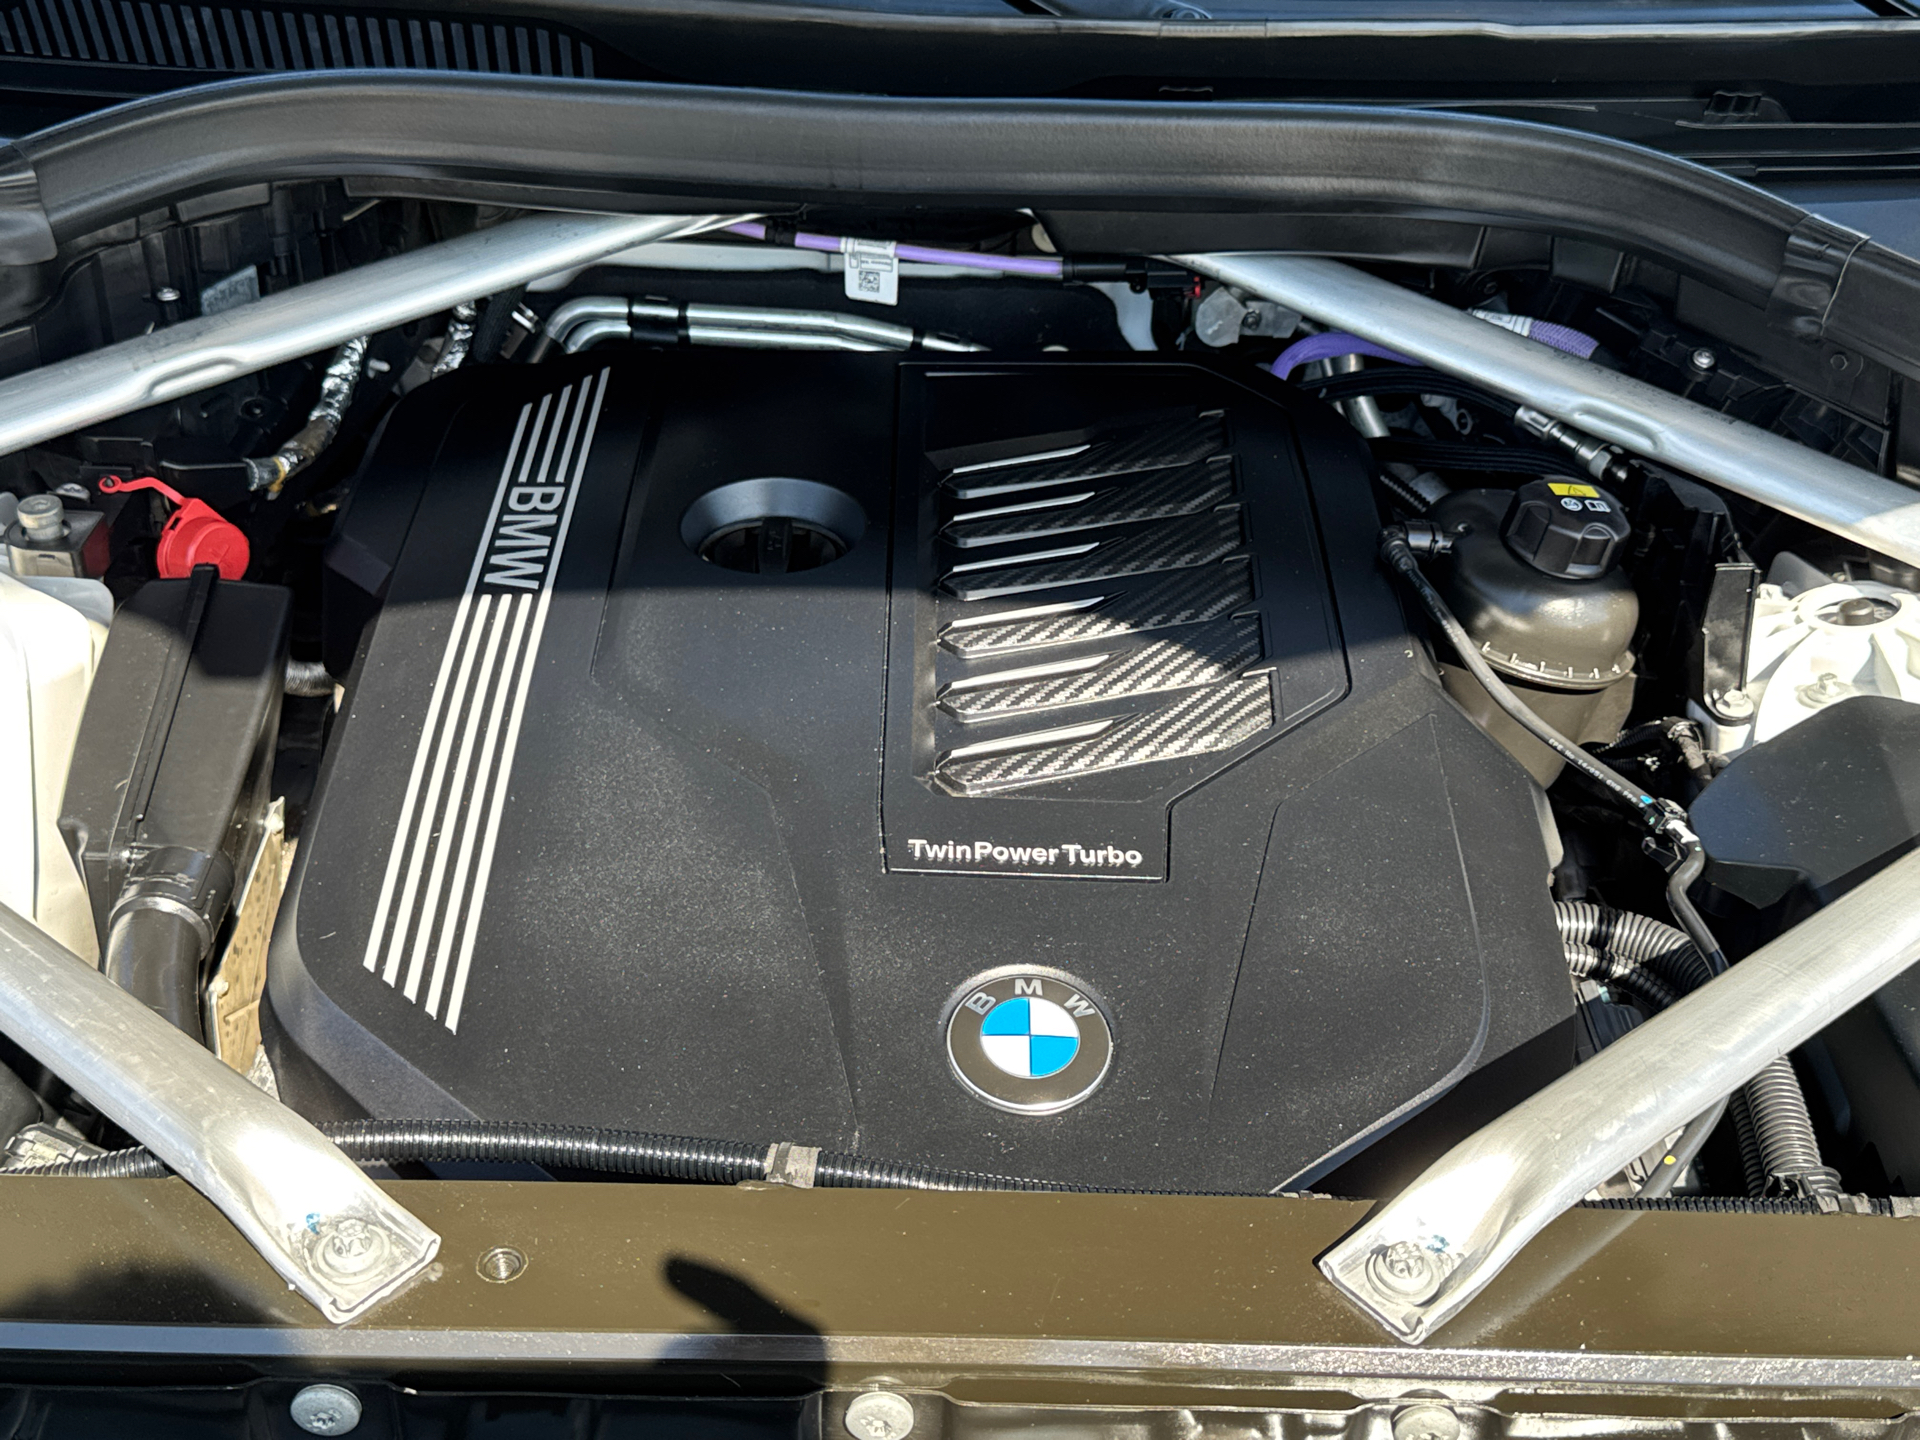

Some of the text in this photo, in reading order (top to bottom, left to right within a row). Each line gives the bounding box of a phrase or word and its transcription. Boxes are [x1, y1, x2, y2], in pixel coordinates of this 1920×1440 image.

[483, 486, 566, 590] BMW
[907, 838, 1143, 866] TwinPower Turbo
[965, 978, 1096, 1018] BMW
